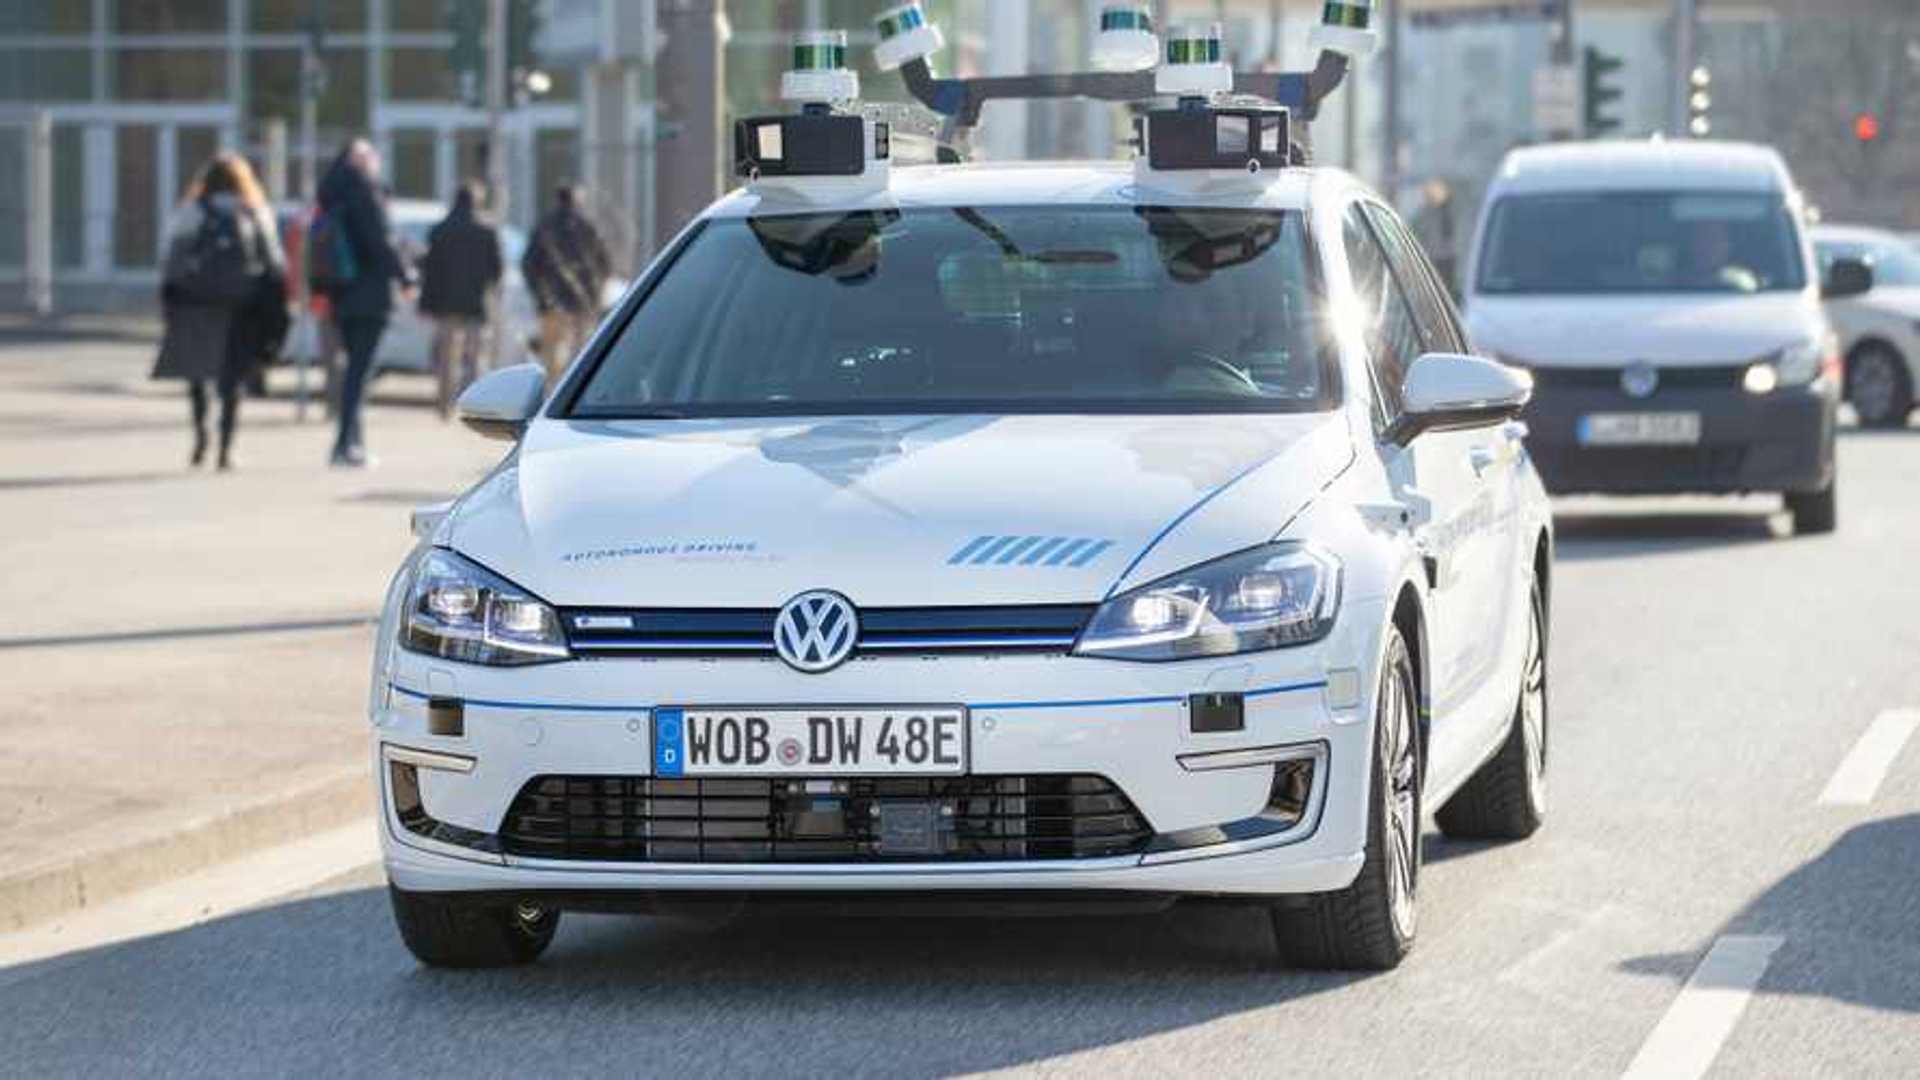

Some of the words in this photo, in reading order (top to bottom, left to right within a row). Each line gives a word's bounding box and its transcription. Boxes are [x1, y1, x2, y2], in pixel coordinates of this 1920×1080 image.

[777, 594, 854, 666] VW
[665, 750, 675, 763] D
[687, 717, 771, 766] WOB
[807, 716, 863, 765] DW
[876, 715, 959, 765] 48E
